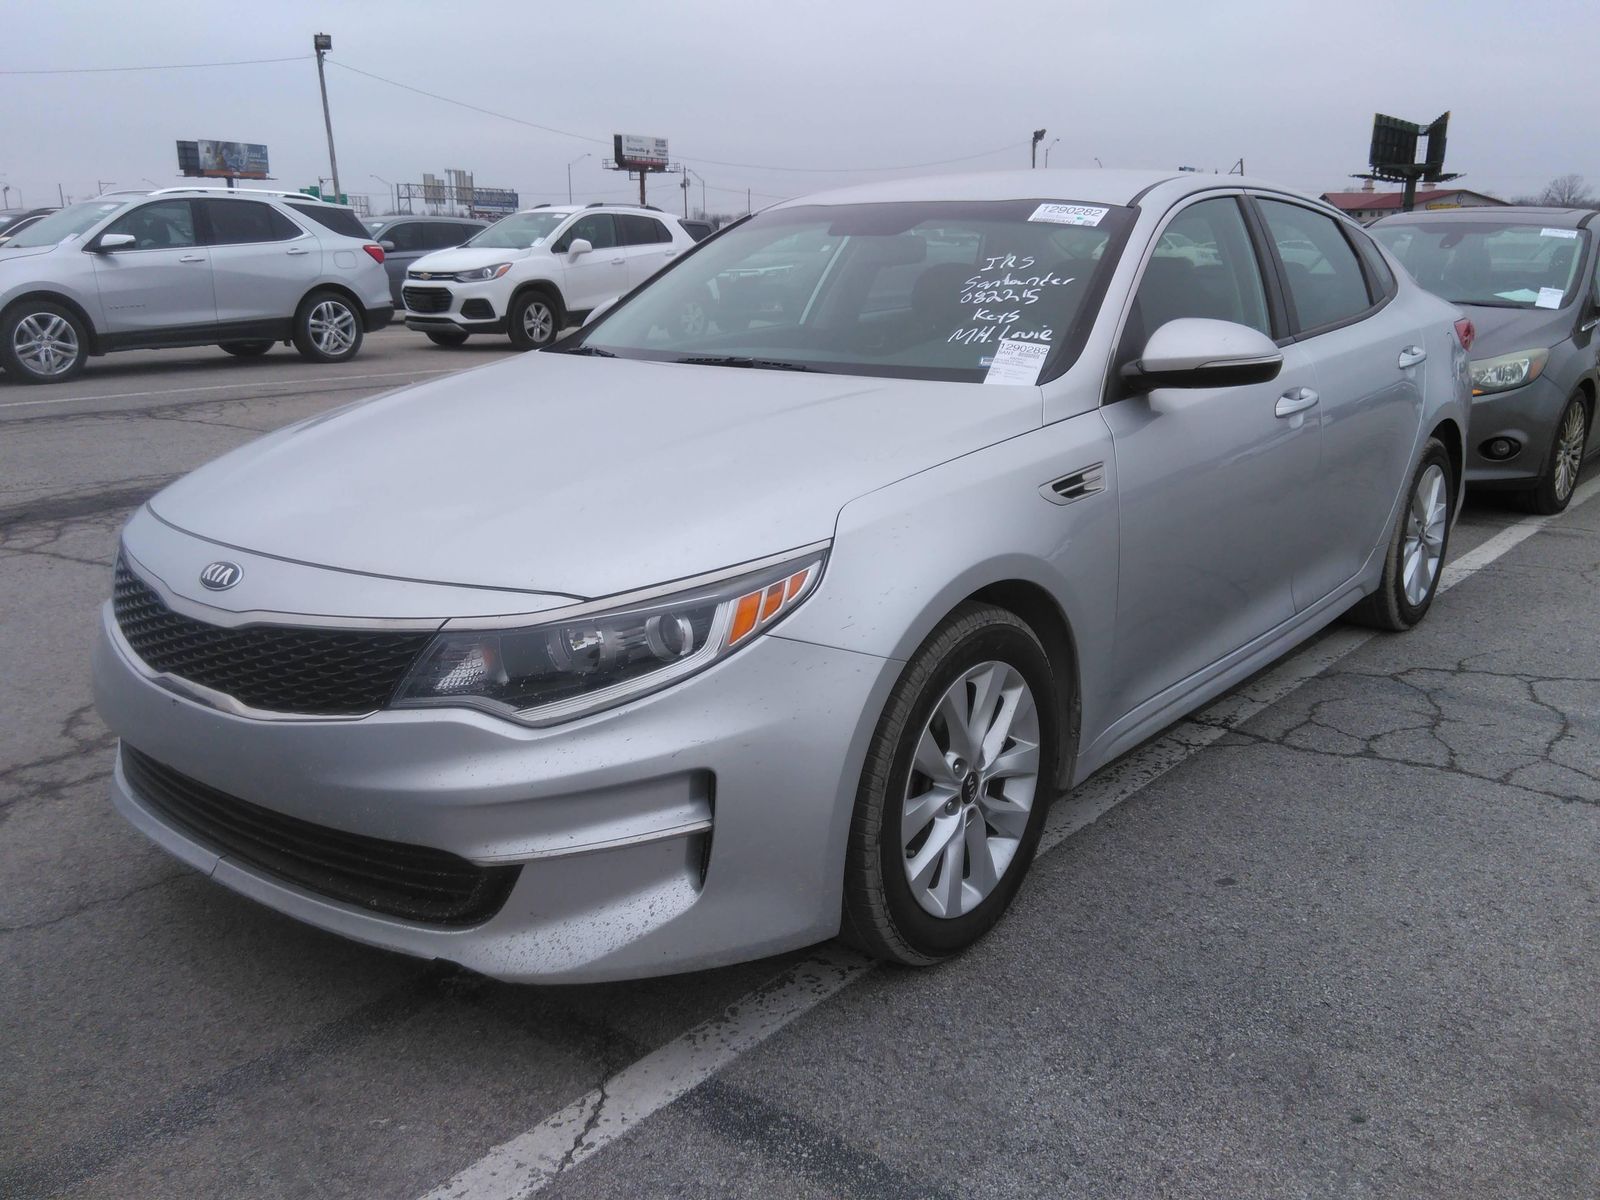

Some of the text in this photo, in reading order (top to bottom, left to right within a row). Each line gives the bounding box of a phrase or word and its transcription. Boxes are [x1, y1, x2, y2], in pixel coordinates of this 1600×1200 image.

[1043, 205, 1103, 217] 1290282
[960, 272, 1076, 293] Santander
[973, 308, 1021, 324] Keys
[1000, 343, 1048, 355] 1290282
[202, 563, 234, 585] KIA
